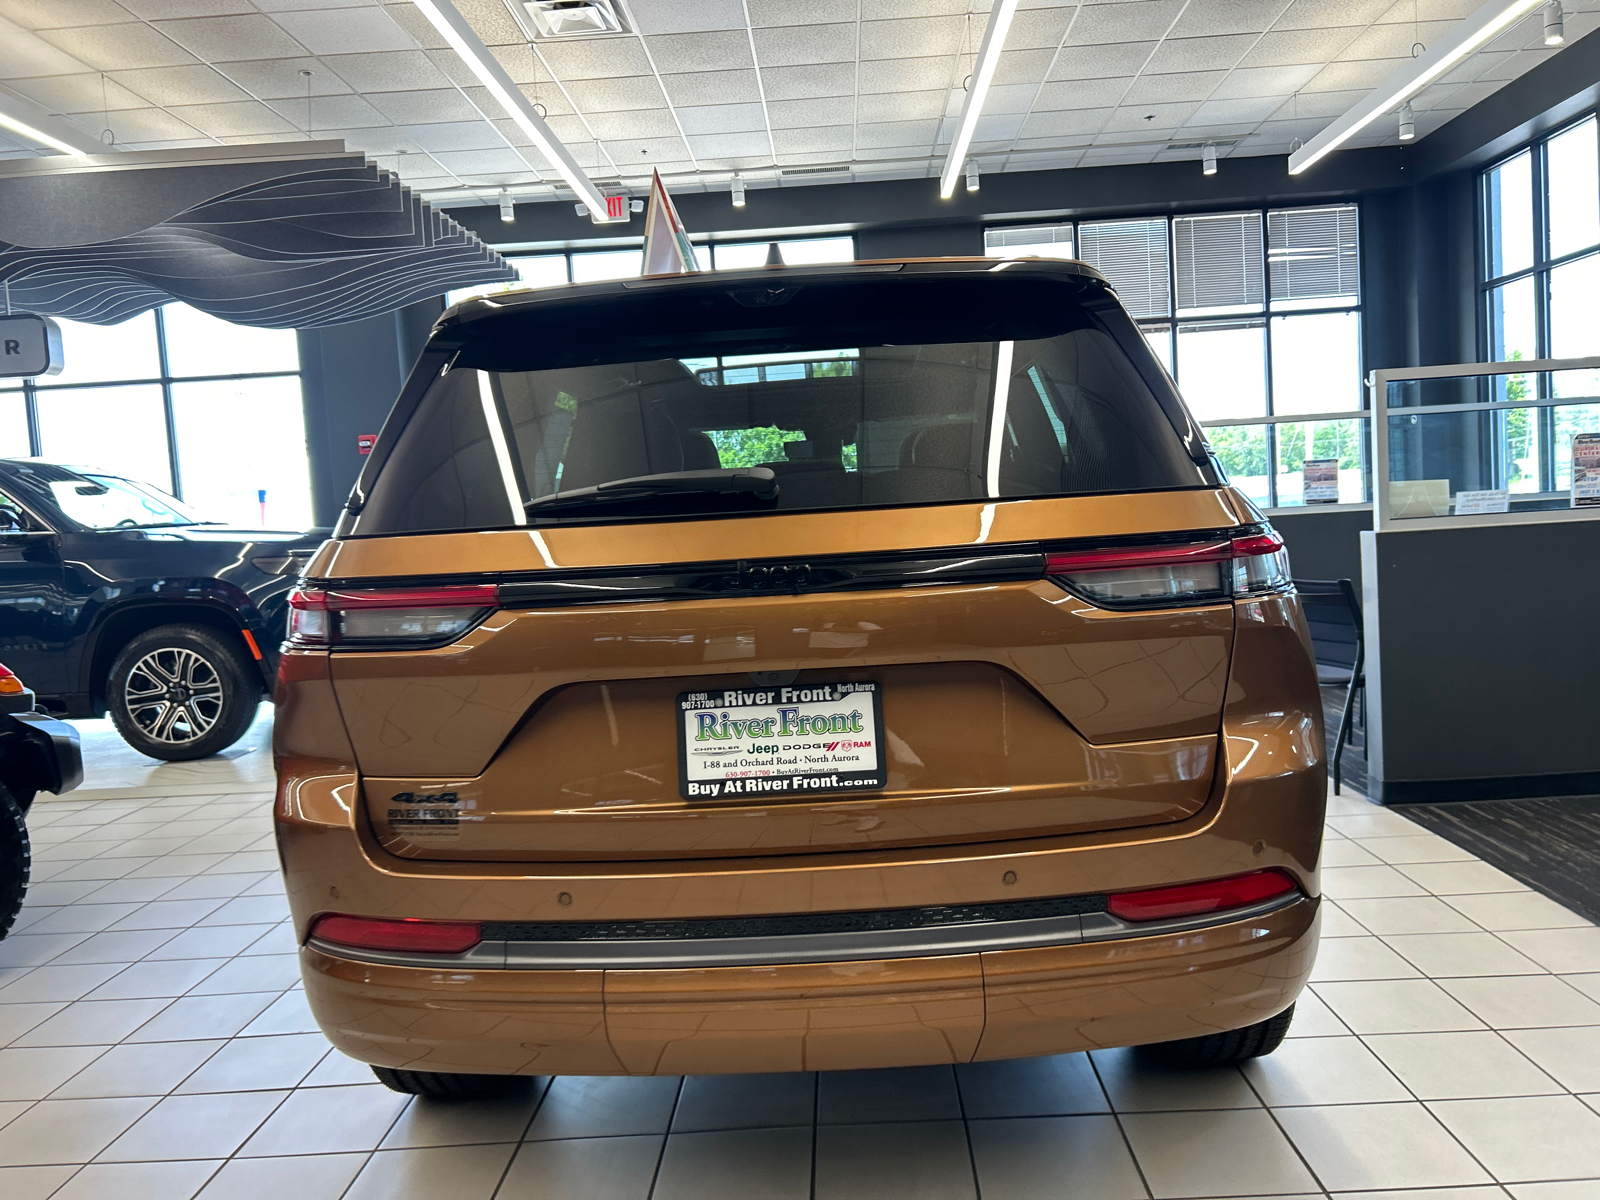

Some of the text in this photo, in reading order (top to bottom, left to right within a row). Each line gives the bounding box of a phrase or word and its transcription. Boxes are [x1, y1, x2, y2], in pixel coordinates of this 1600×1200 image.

[604, 196, 623, 217] XIT
[4, 339, 21, 355] R
[837, 682, 876, 693] North Aurora
[688, 693, 708, 702] (630)
[723, 686, 832, 707] River Front
[681, 700, 715, 710] 907-1700
[747, 743, 780, 755] Jeep
[782, 742, 831, 751] DODGE
[703, 754, 860, 769] I-88 and Orchard Road North Aurora
[725, 769, 771, 778] 630-907-1700
[688, 782, 720, 797] Buy
[723, 780, 743, 793] At
[745, 778, 790, 792] River
[387, 808, 460, 818] RIVER FRONT
